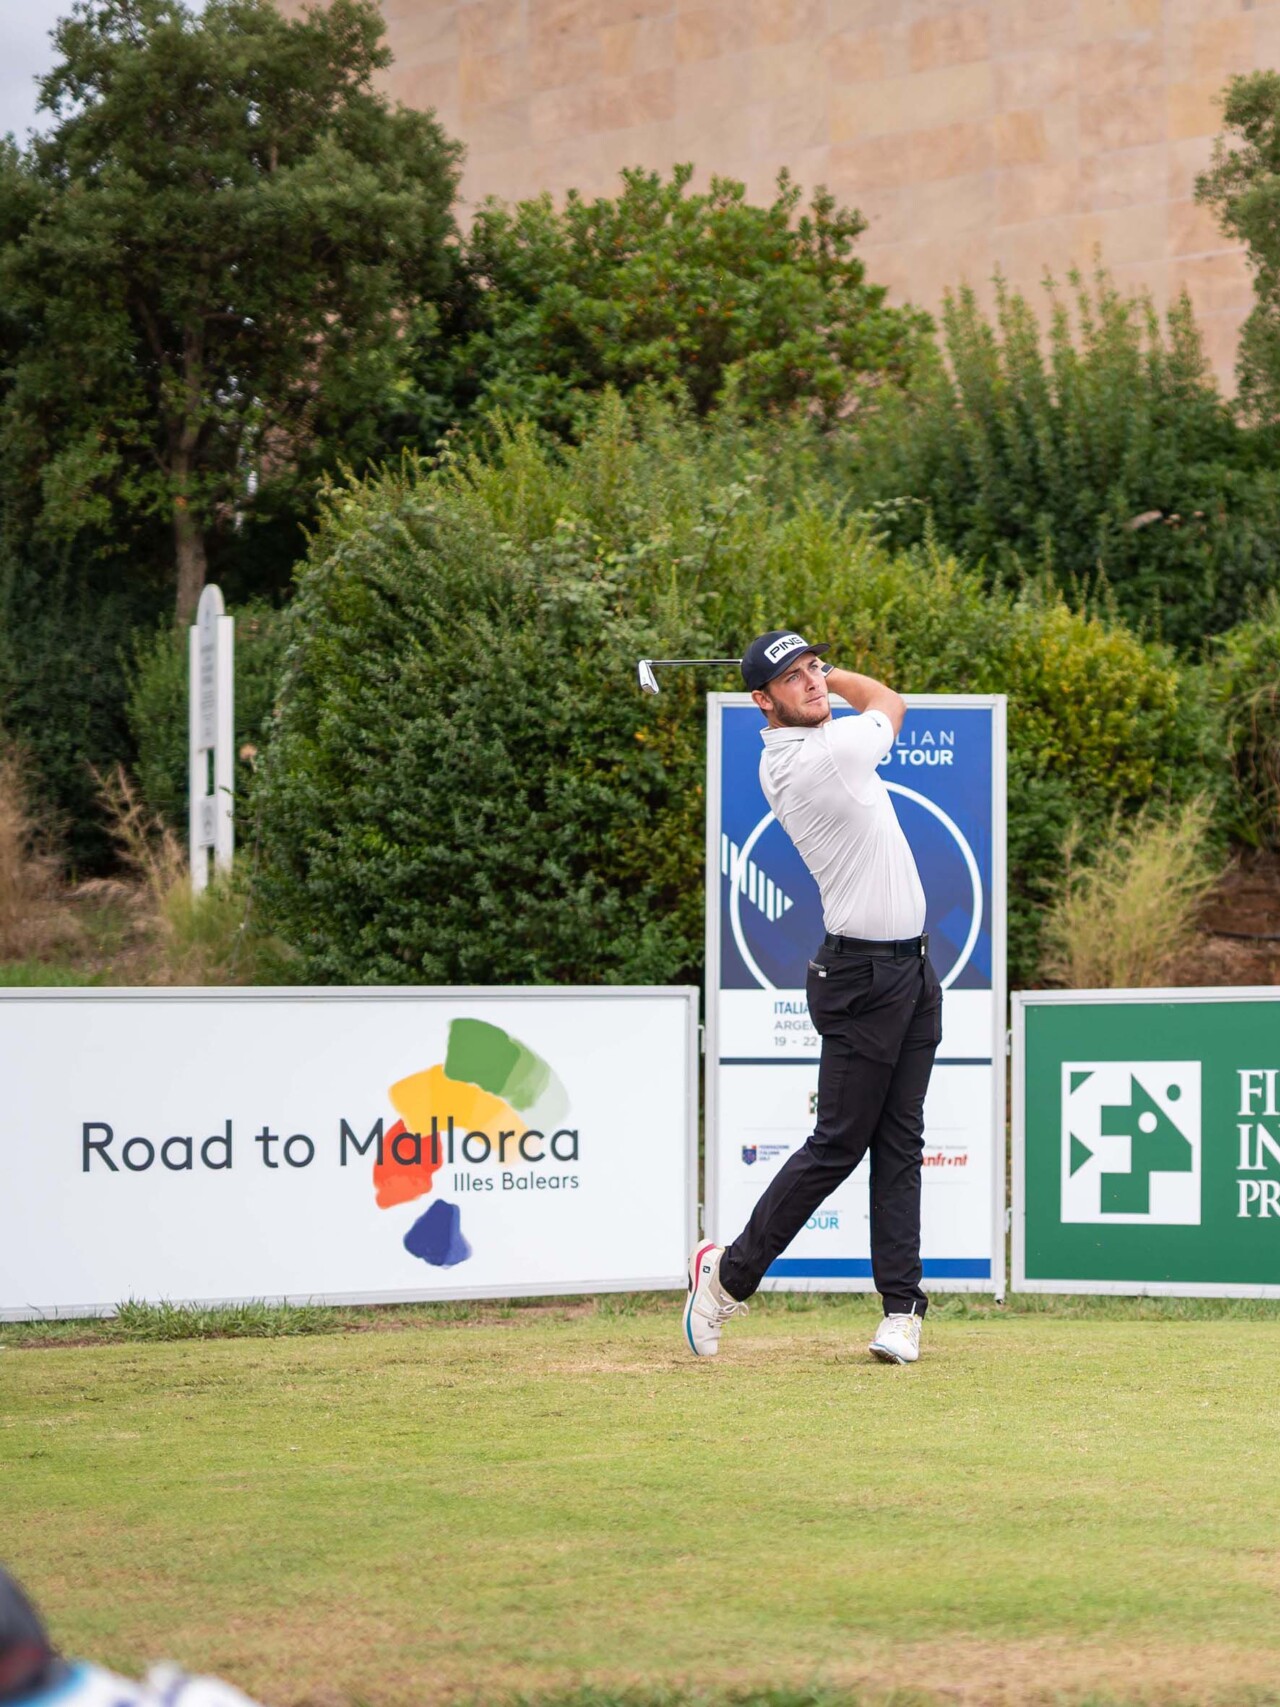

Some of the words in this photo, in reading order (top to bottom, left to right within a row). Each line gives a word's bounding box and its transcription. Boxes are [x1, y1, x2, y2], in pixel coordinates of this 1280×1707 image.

[769, 636, 803, 659] PING
[895, 730, 955, 746] LIAN
[896, 749, 954, 766] TOUR
[774, 1036, 786, 1047] 19
[802, 1036, 818, 1047] 22
[82, 1119, 233, 1173] Road
[255, 1126, 315, 1169] to
[340, 1115, 579, 1167] Mallorca
[454, 1173, 494, 1192] Illes
[502, 1171, 579, 1191] Balears
[805, 1216, 839, 1230] OUR
